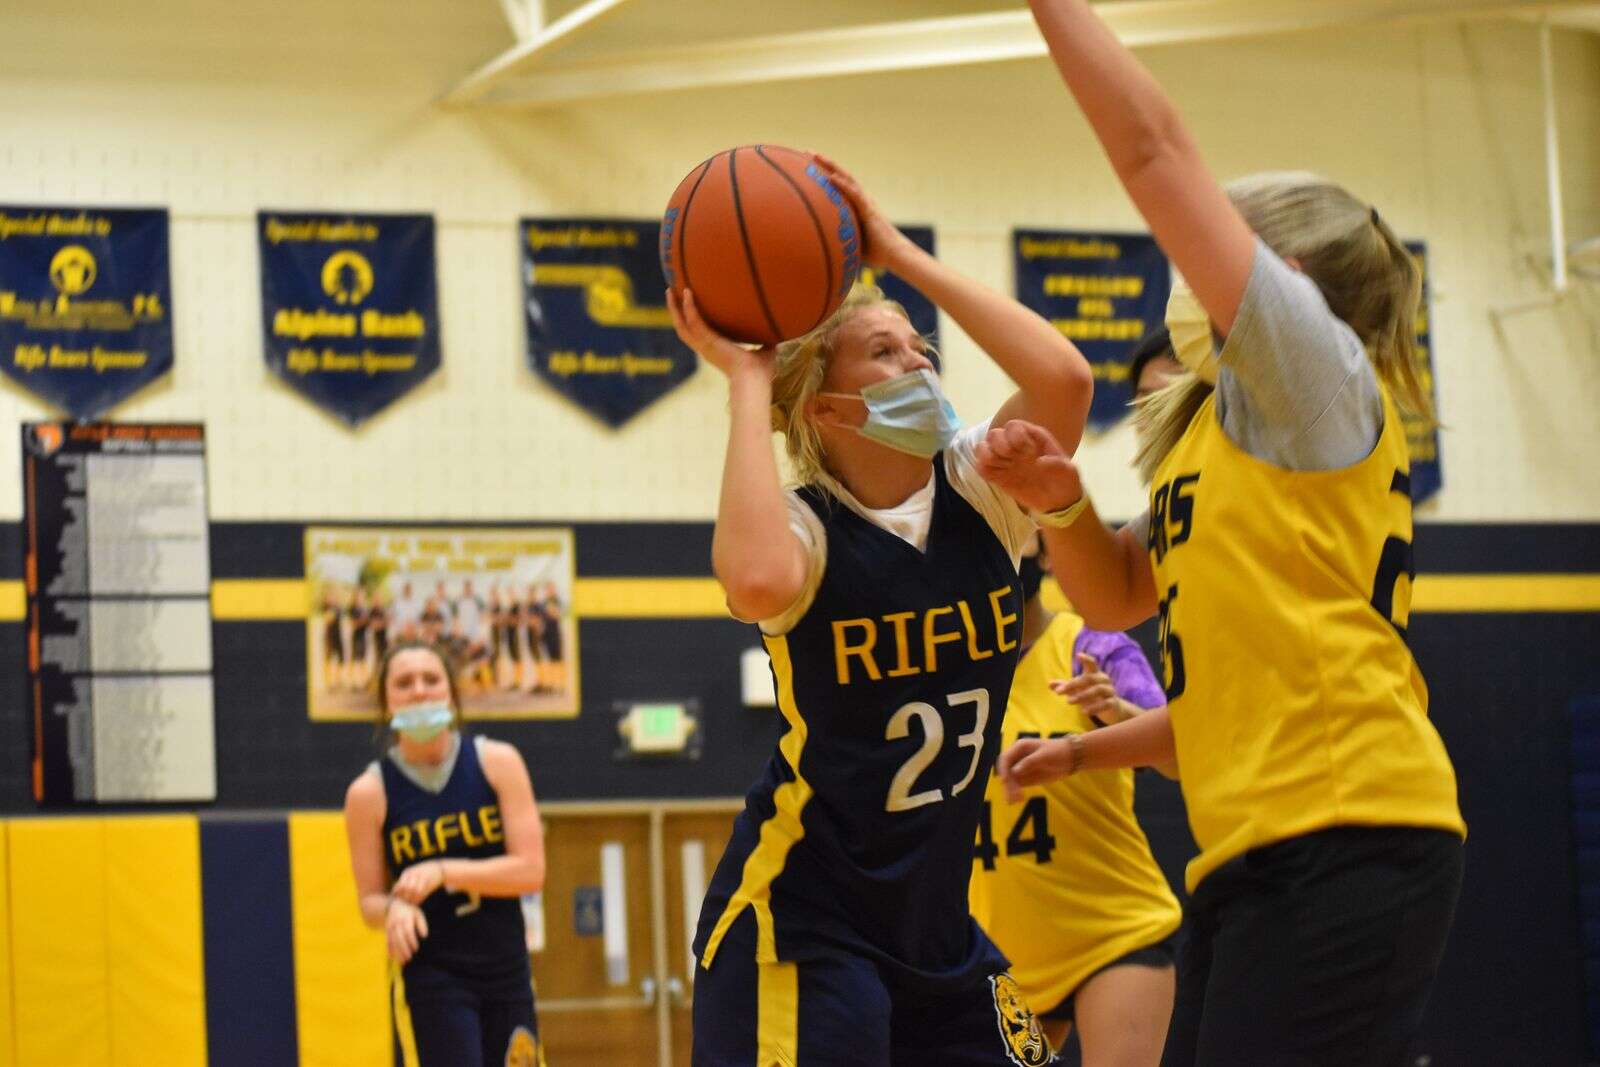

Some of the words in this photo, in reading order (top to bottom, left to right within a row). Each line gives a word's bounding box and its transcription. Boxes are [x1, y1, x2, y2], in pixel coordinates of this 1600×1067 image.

[274, 308, 357, 340] Alpine
[361, 308, 425, 337] Bank
[832, 585, 1017, 684] RIFLE
[885, 688, 990, 812] 23
[389, 805, 504, 865] RIFLE
[973, 796, 1056, 872] 44
